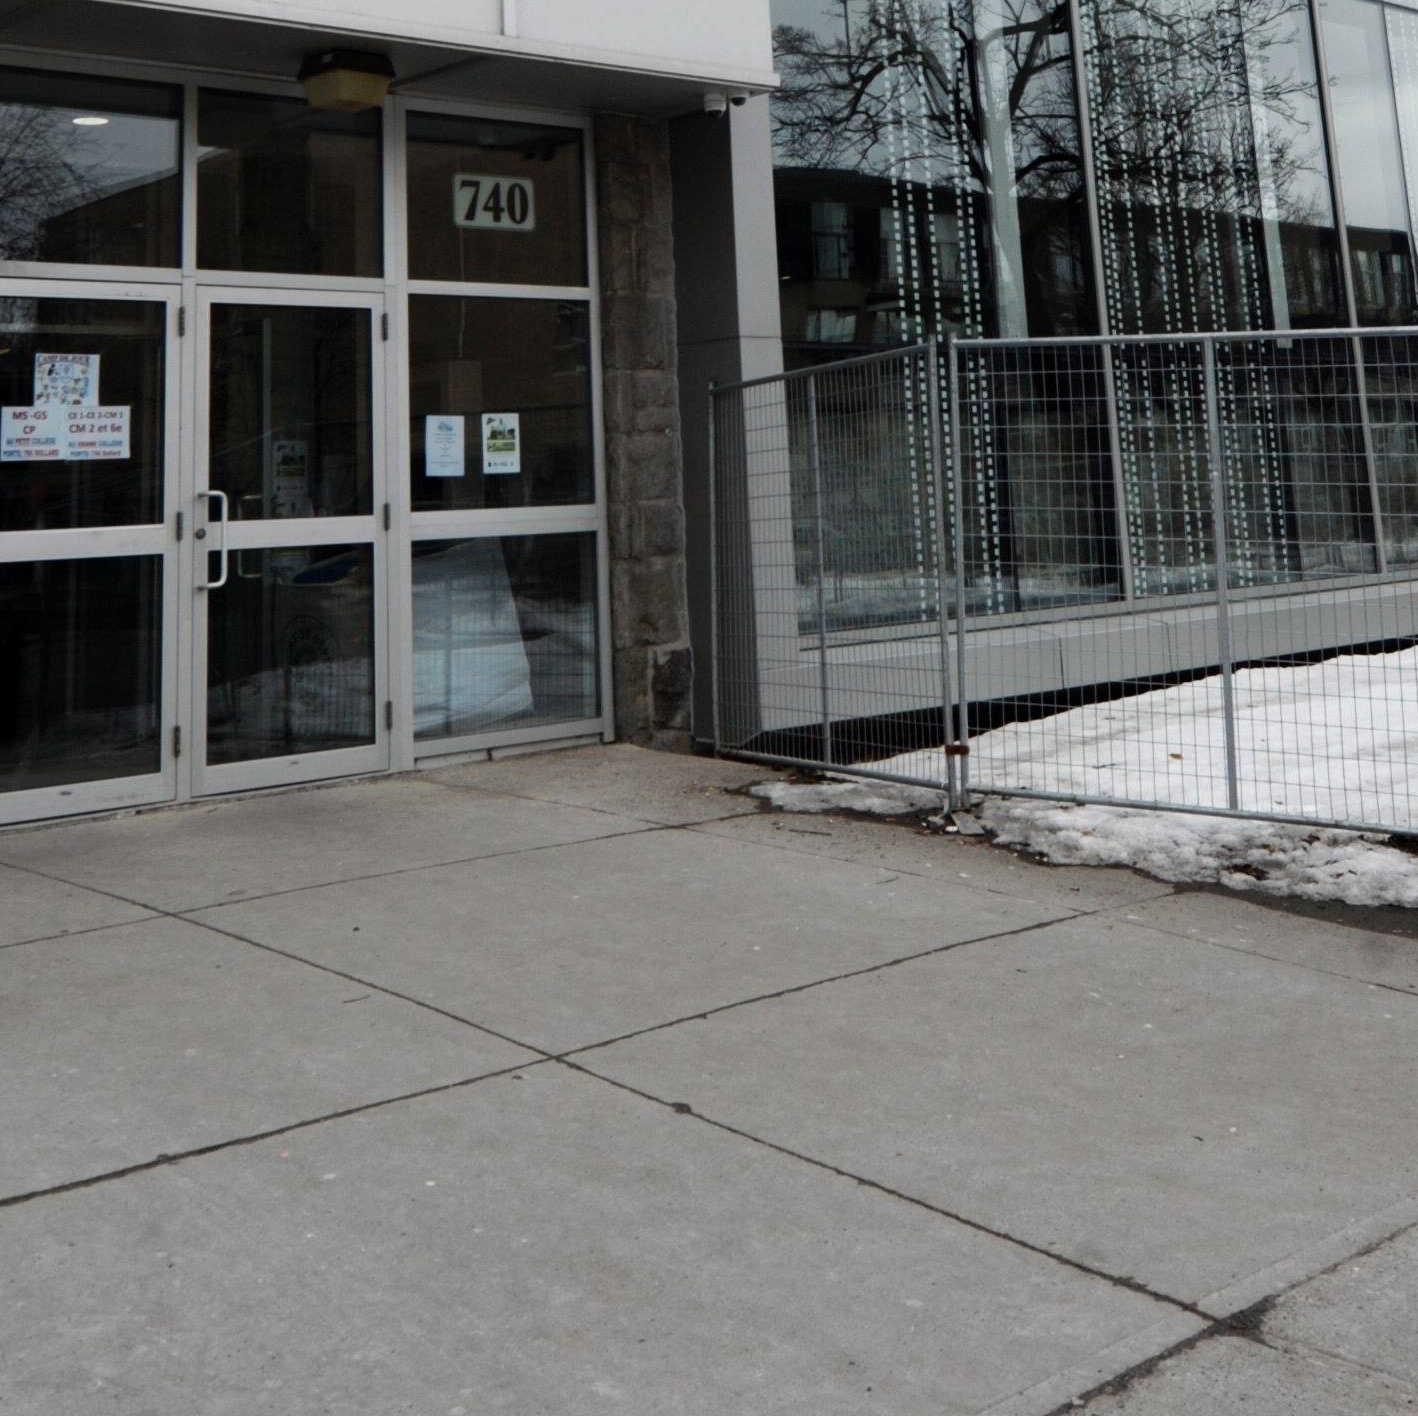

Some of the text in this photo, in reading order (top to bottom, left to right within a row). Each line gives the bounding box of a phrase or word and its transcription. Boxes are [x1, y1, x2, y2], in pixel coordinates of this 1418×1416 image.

[458, 179, 530, 225] 740
[12, 411, 29, 420] MS
[22, 425, 37, 435] CP
[68, 423, 123, 433] CM 2 et 6e
